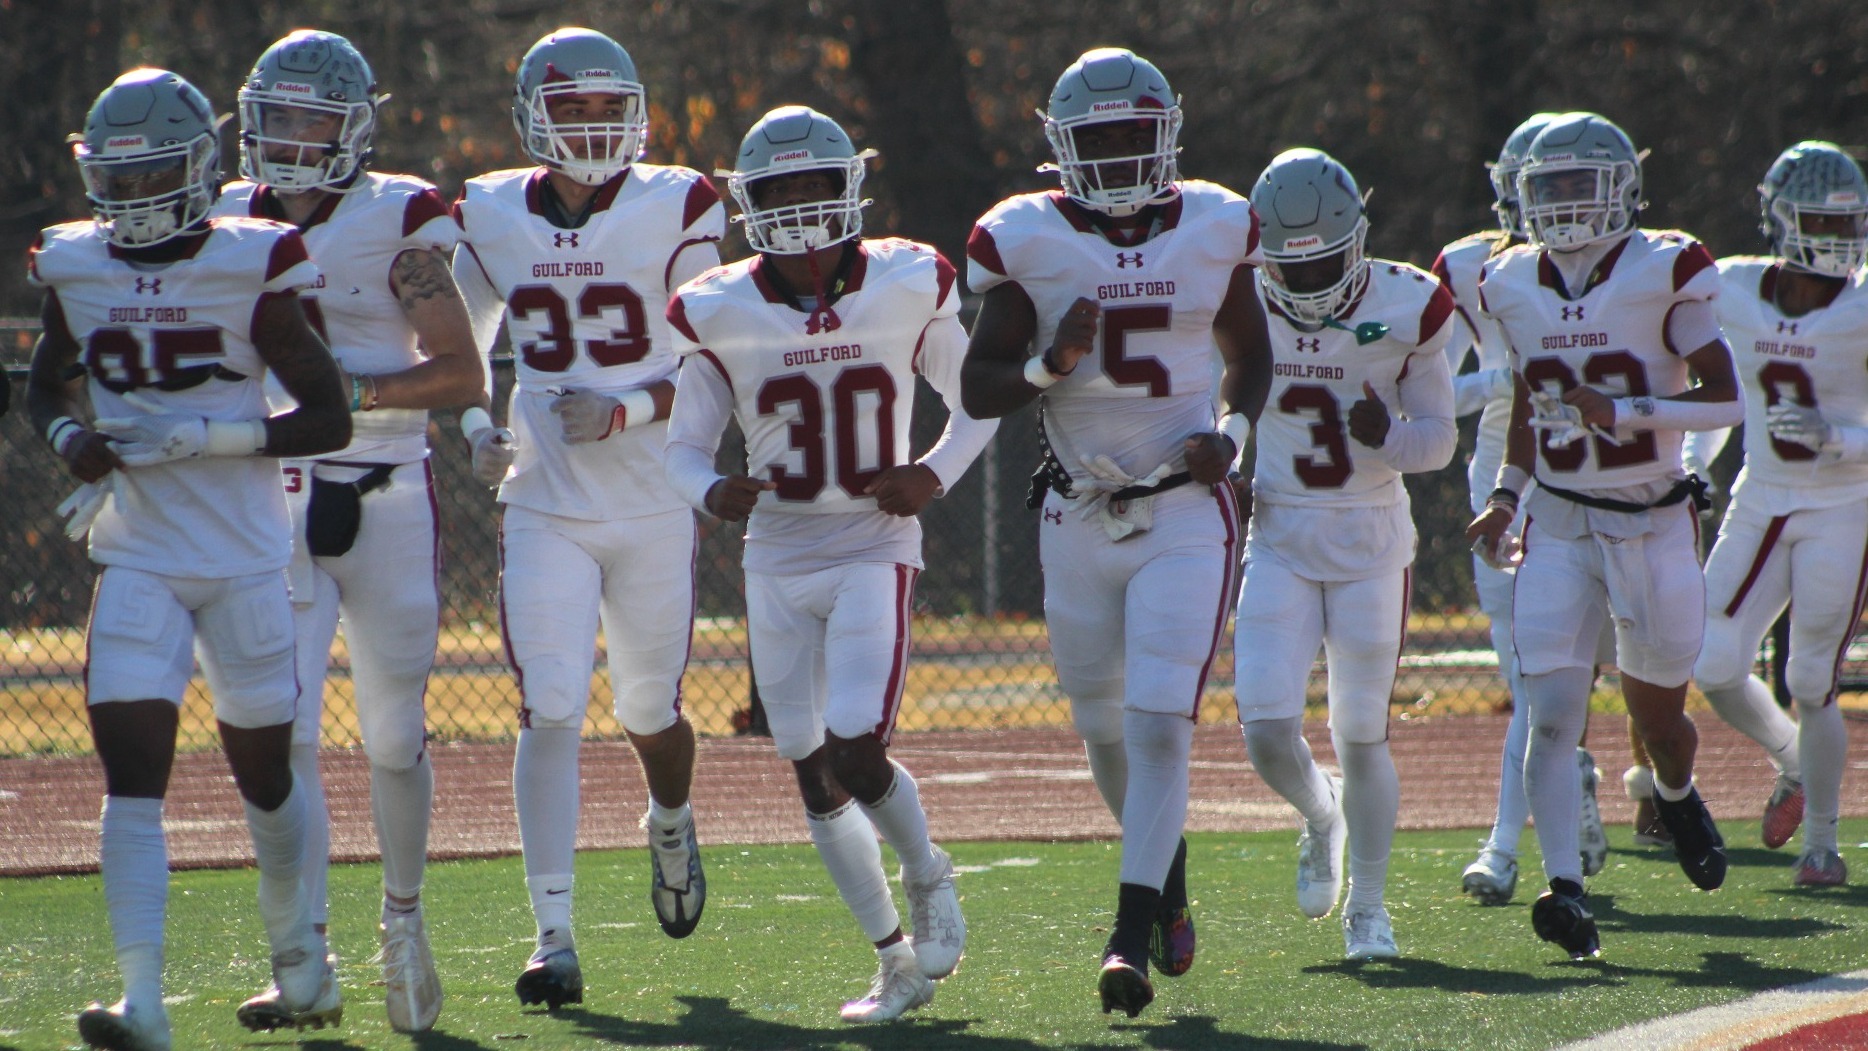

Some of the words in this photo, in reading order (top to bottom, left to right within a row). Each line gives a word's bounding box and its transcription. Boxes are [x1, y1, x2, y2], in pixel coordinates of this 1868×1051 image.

[275, 82, 311, 93] Riddell
[1093, 101, 1128, 112] Riddell
[774, 151, 808, 162] Riddell
[1287, 237, 1318, 248] Riddell
[532, 262, 604, 277] GUILFORD
[1097, 281, 1176, 300] GUILFORD
[109, 307, 187, 322] GUILFORD
[507, 282, 652, 372] 33
[1541, 333, 1608, 349] GUILFORD
[783, 344, 862, 366] GUILFORD
[1101, 303, 1172, 397] 5
[1755, 341, 1816, 359] GUILFORD
[1274, 363, 1344, 380] GUILFORD
[755, 362, 898, 503] 30
[1277, 383, 1354, 490] 3
